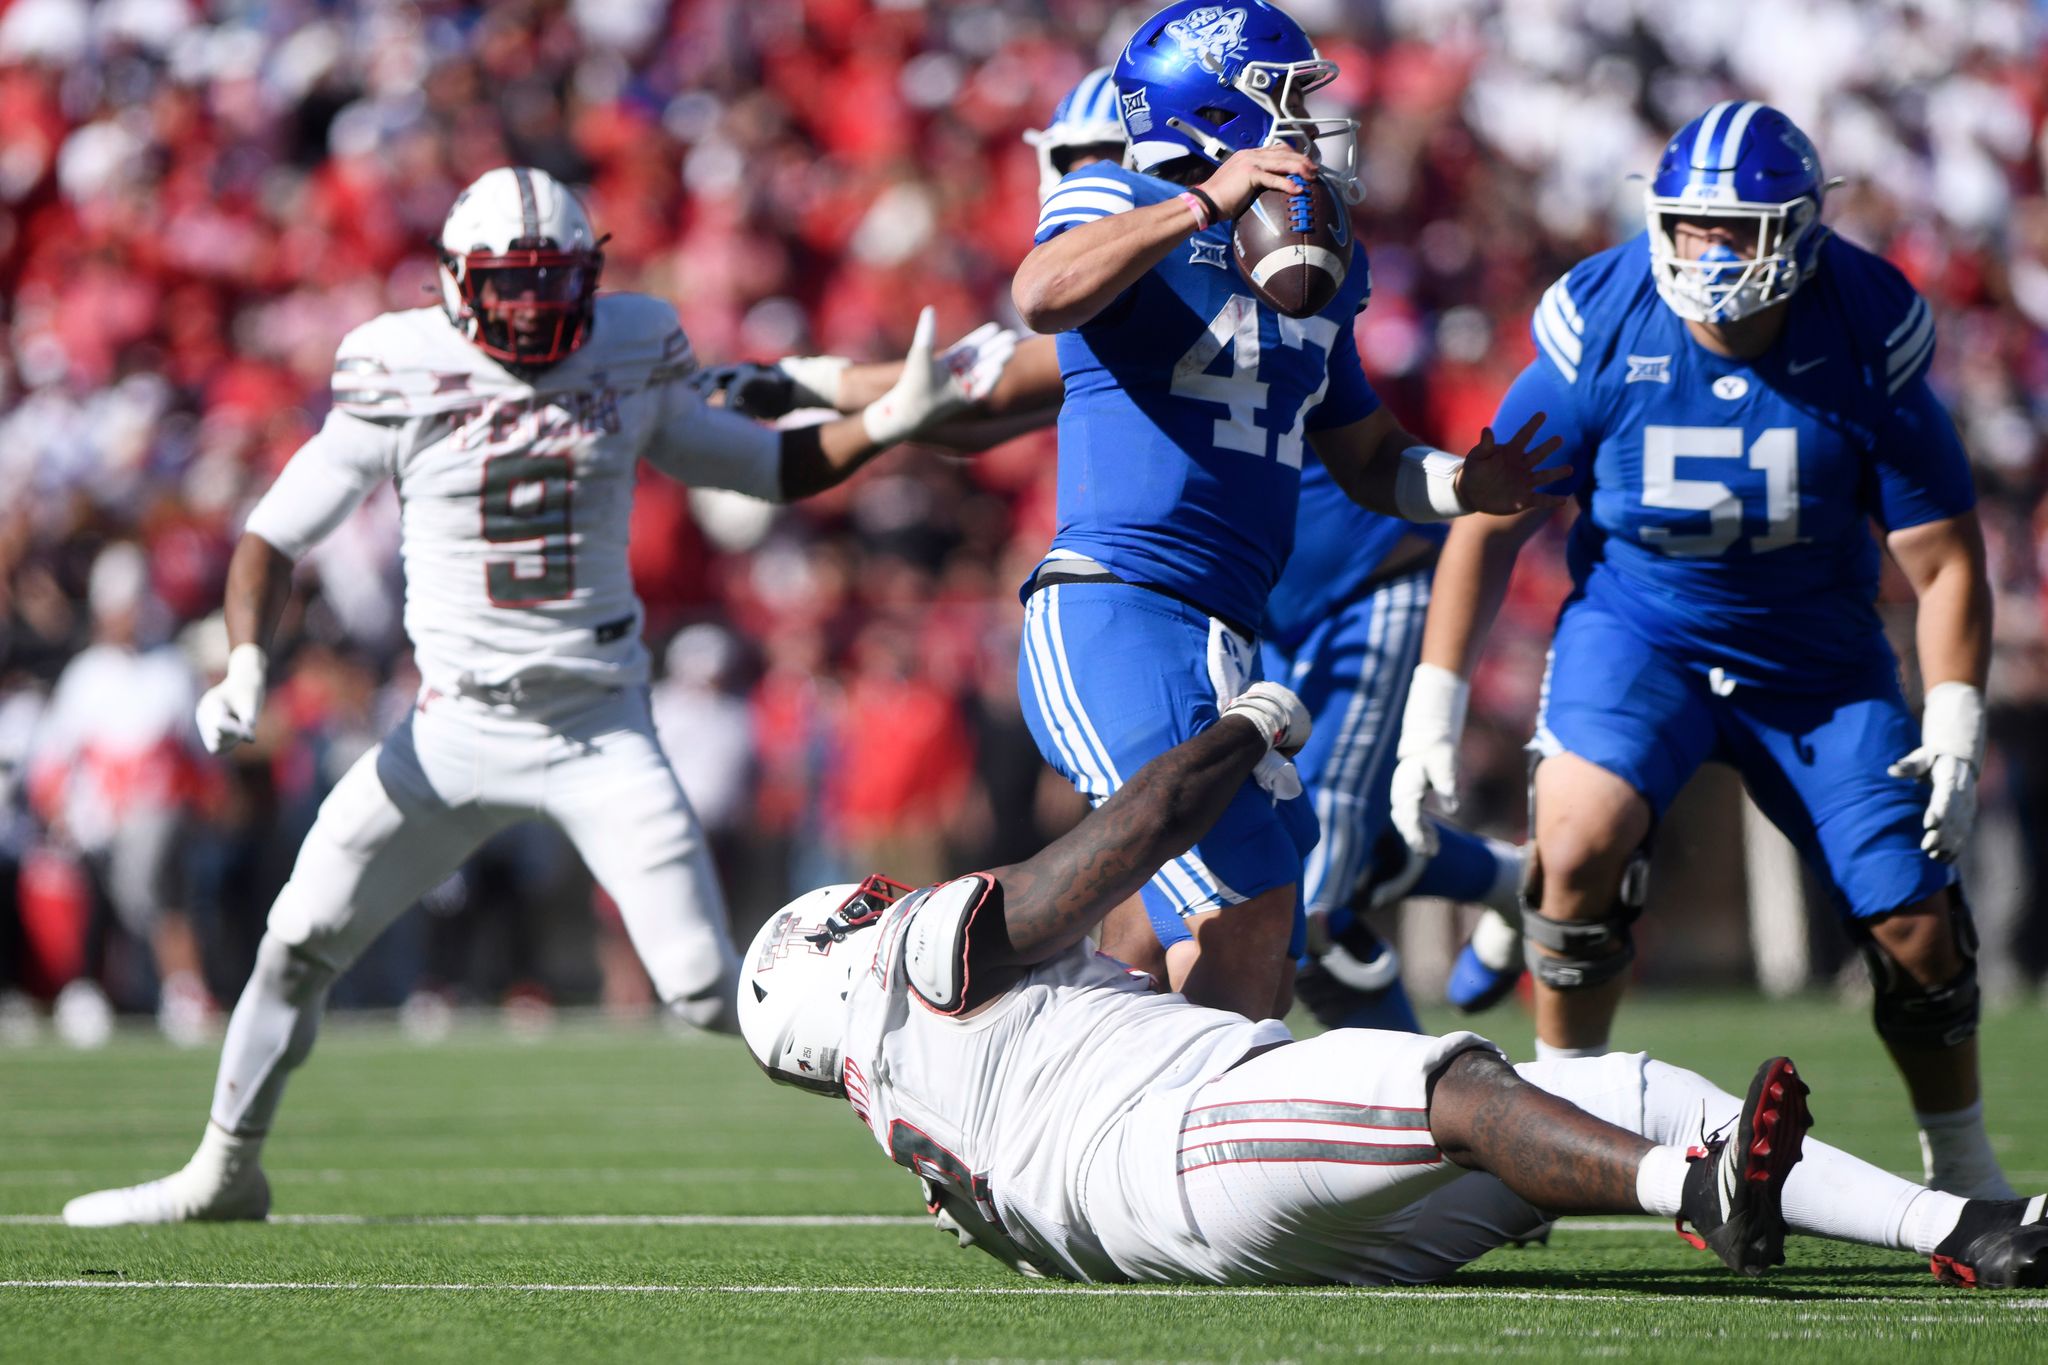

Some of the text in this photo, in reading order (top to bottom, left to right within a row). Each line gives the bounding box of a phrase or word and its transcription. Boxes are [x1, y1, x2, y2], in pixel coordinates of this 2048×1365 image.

[1168, 293, 1341, 471] 47
[480, 450, 575, 609] 9
[1637, 425, 1802, 558] 51
